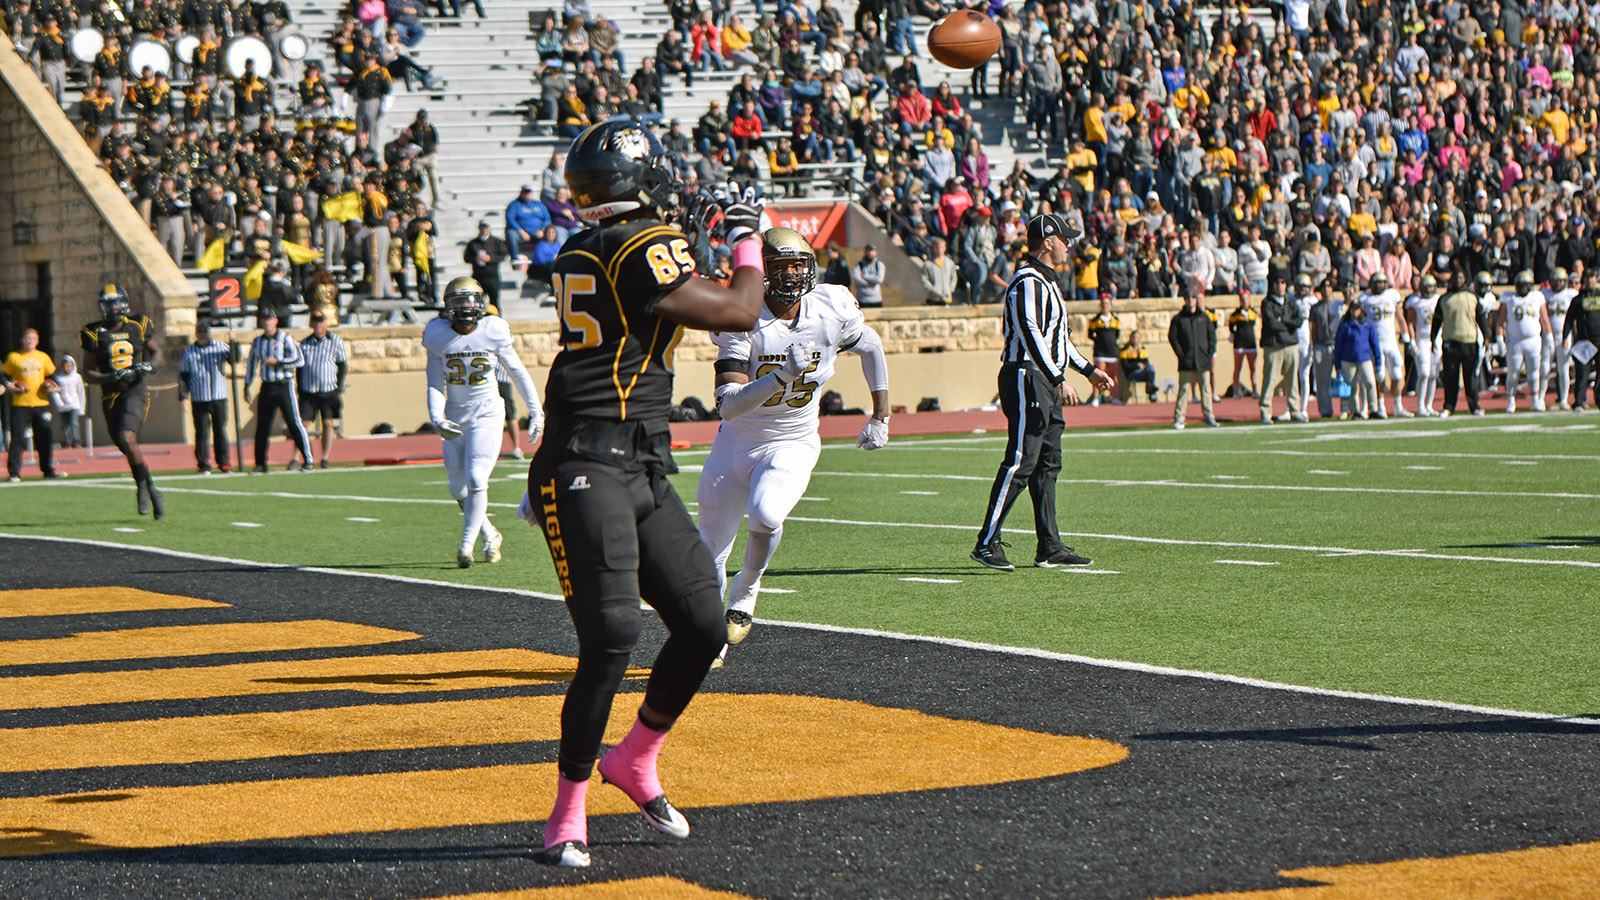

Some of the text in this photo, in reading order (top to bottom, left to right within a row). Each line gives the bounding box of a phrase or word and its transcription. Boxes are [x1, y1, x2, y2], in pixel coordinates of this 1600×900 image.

[645, 238, 696, 285] 85
[215, 277, 241, 308] 2
[109, 341, 133, 370] 8
[758, 354, 788, 362] EMPOR
[446, 357, 491, 386] 22
[540, 477, 574, 598] TIGERS
